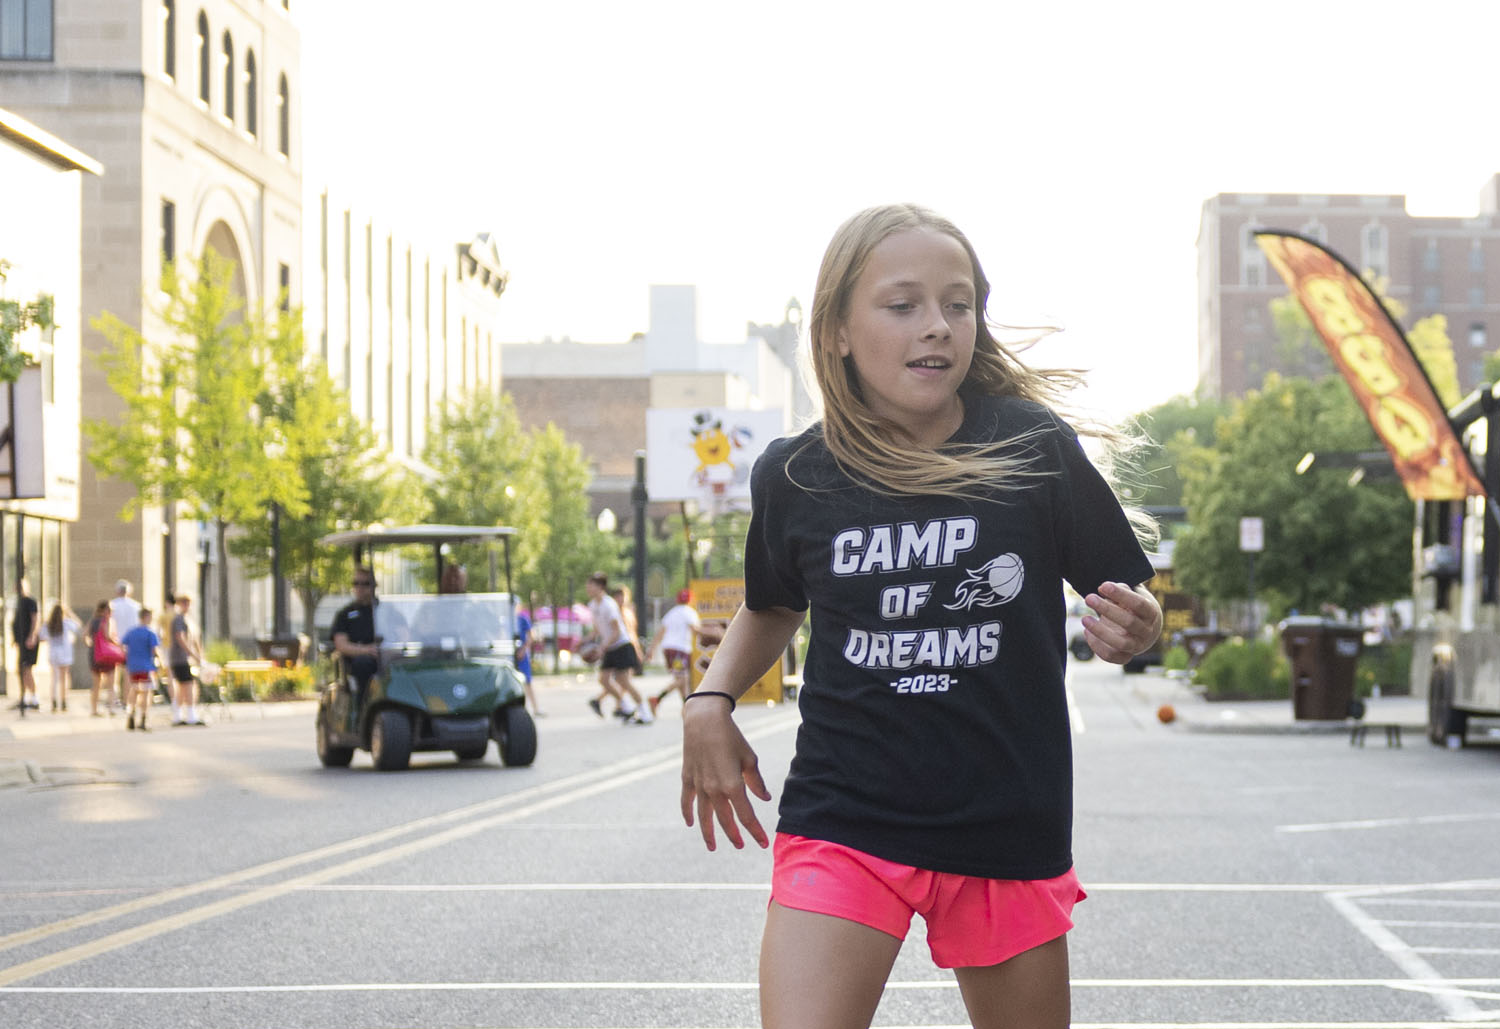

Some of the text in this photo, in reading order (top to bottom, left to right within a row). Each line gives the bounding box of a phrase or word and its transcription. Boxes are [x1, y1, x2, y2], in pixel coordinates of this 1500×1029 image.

[831, 516, 979, 577] CAMP
[879, 581, 936, 620] OF
[842, 620, 1003, 669] DREAMS
